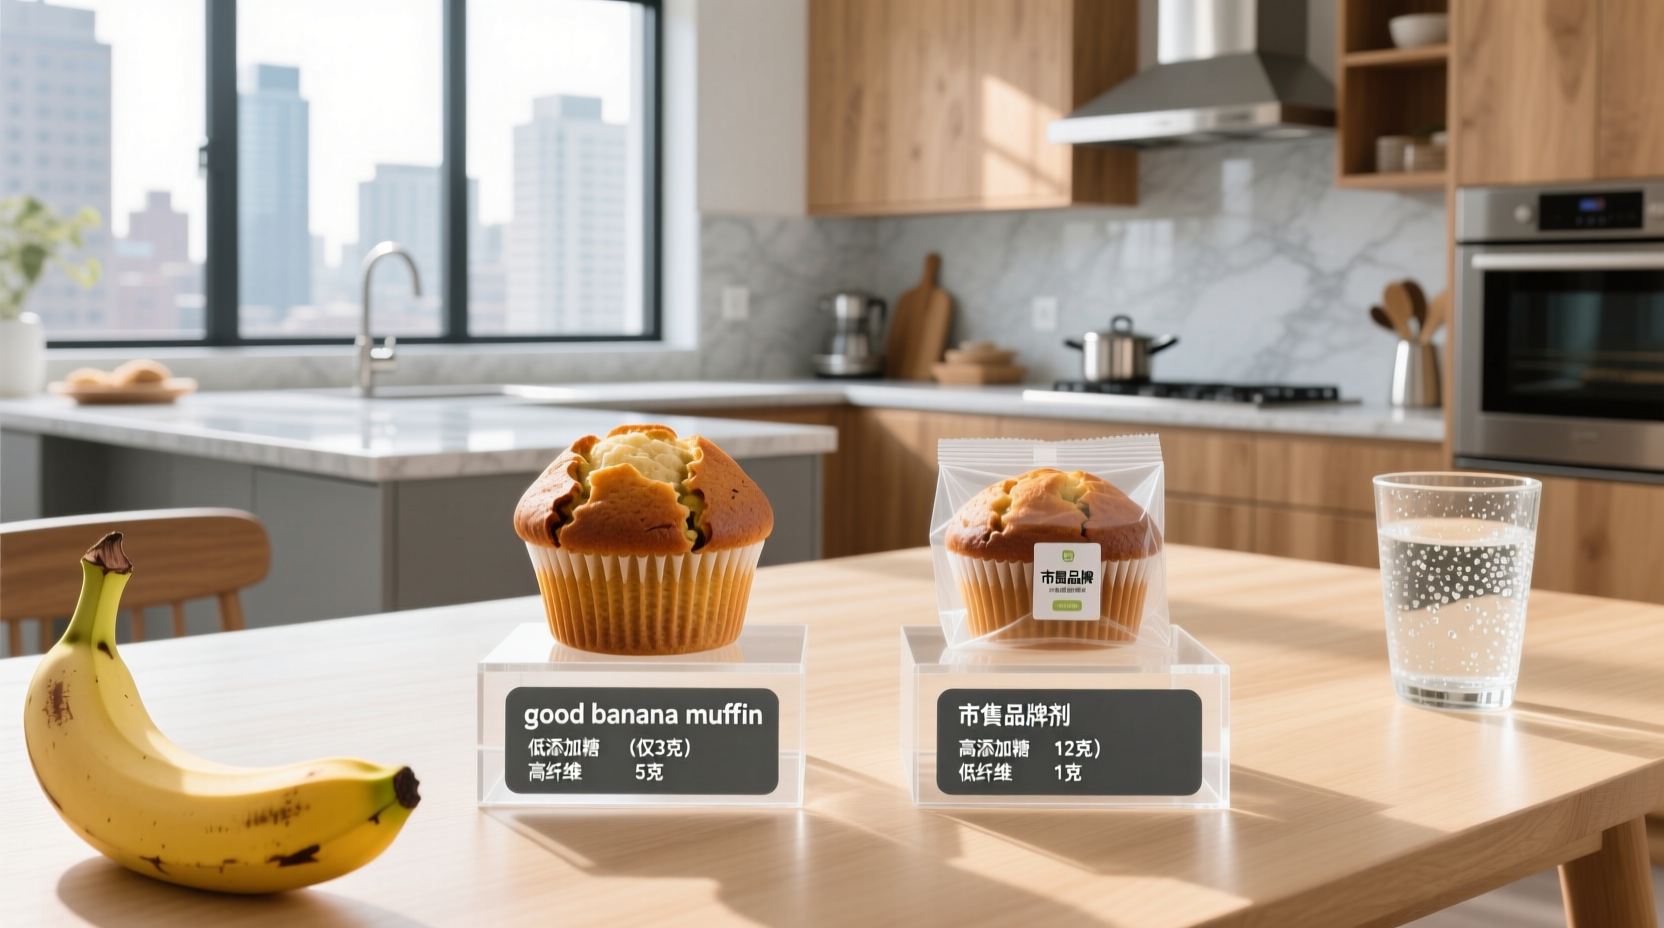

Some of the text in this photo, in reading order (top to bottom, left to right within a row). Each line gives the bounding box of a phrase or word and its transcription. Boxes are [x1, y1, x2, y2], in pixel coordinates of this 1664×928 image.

[524, 702, 763, 731] good banana muffin
[528, 762, 664, 782] 高纤维 5克
[958, 763, 1083, 782] 低纤维 1克
